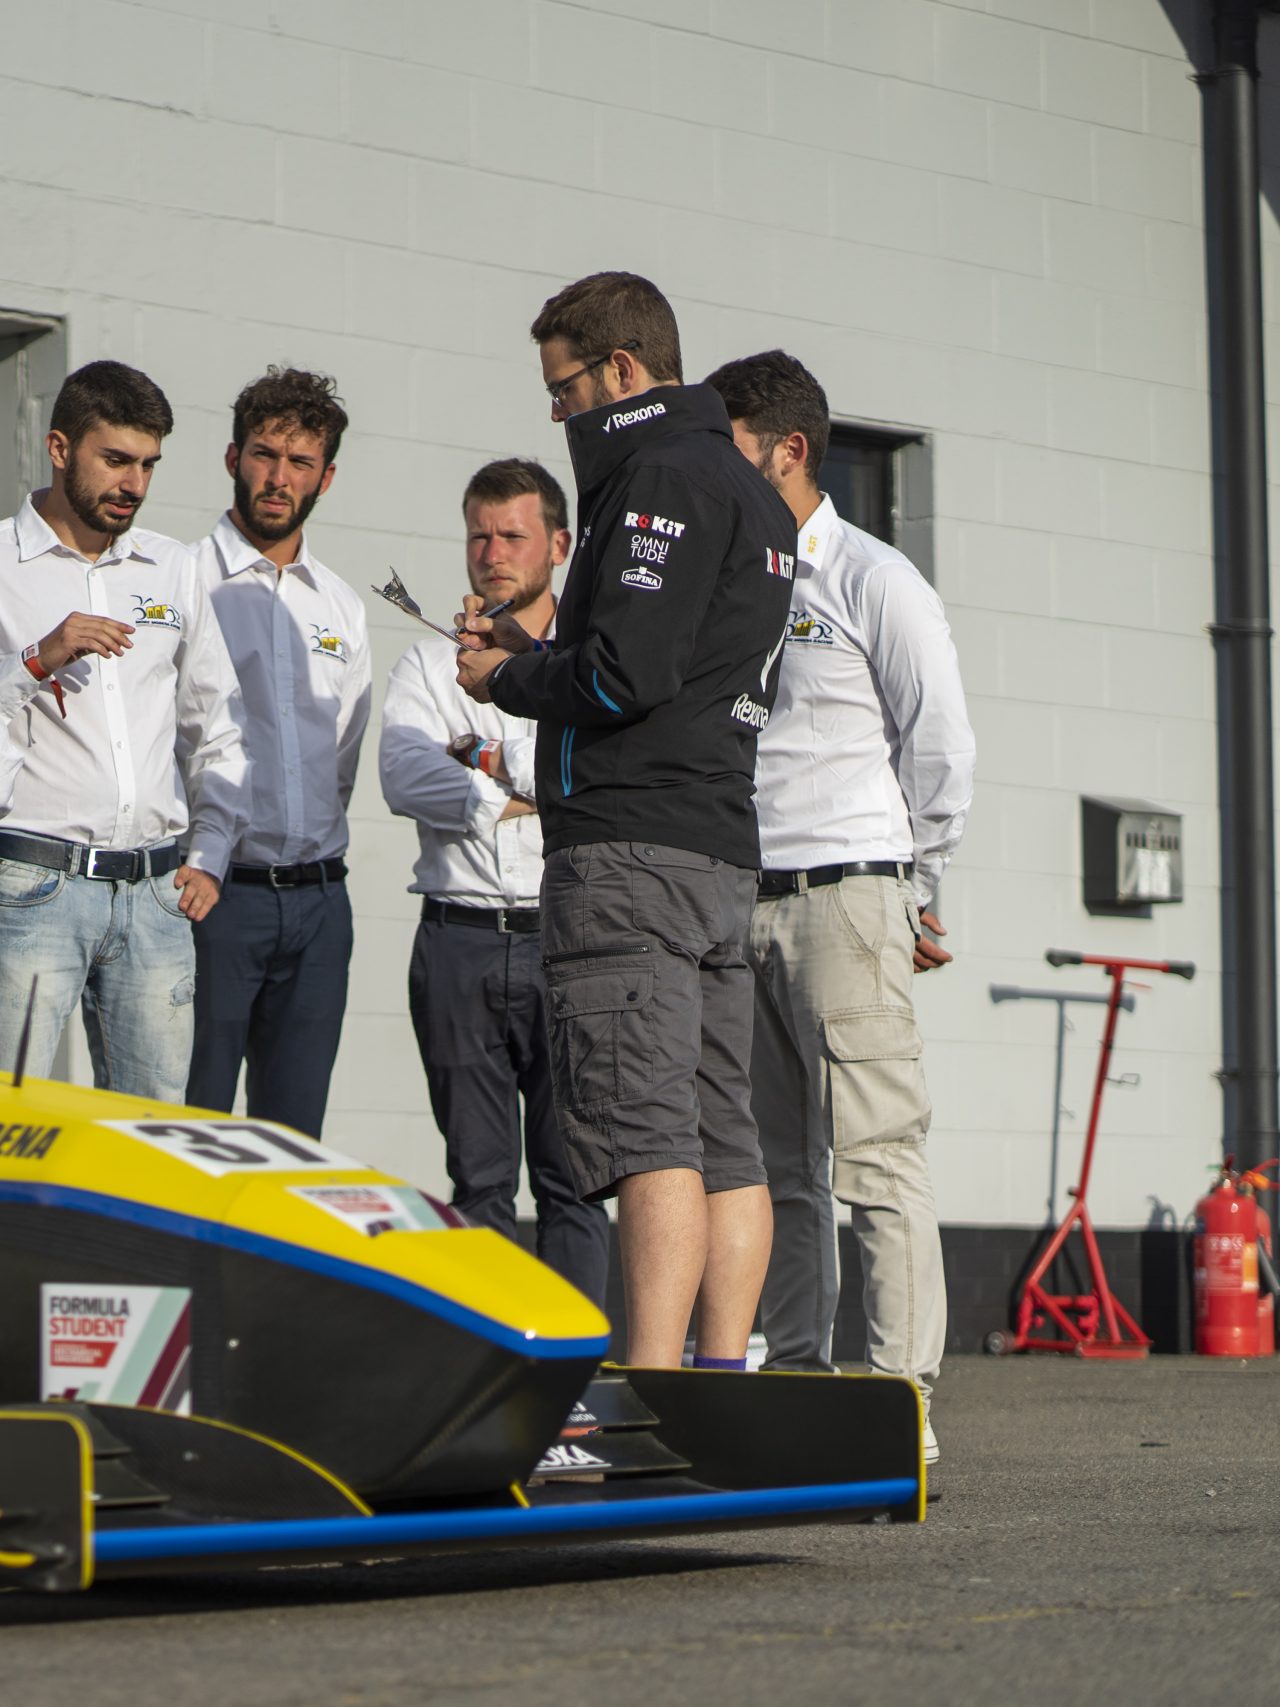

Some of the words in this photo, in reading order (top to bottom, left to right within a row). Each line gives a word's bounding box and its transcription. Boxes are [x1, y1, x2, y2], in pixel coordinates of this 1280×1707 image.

[612, 402, 666, 430] Rexona
[631, 534, 670, 553] OMNI
[630, 545, 667, 564] TUDE
[624, 573, 658, 586] SOFINA
[730, 693, 770, 728] Rexona
[50, 1297, 129, 1316] FORMULA
[50, 1317, 127, 1337] STUDENT
